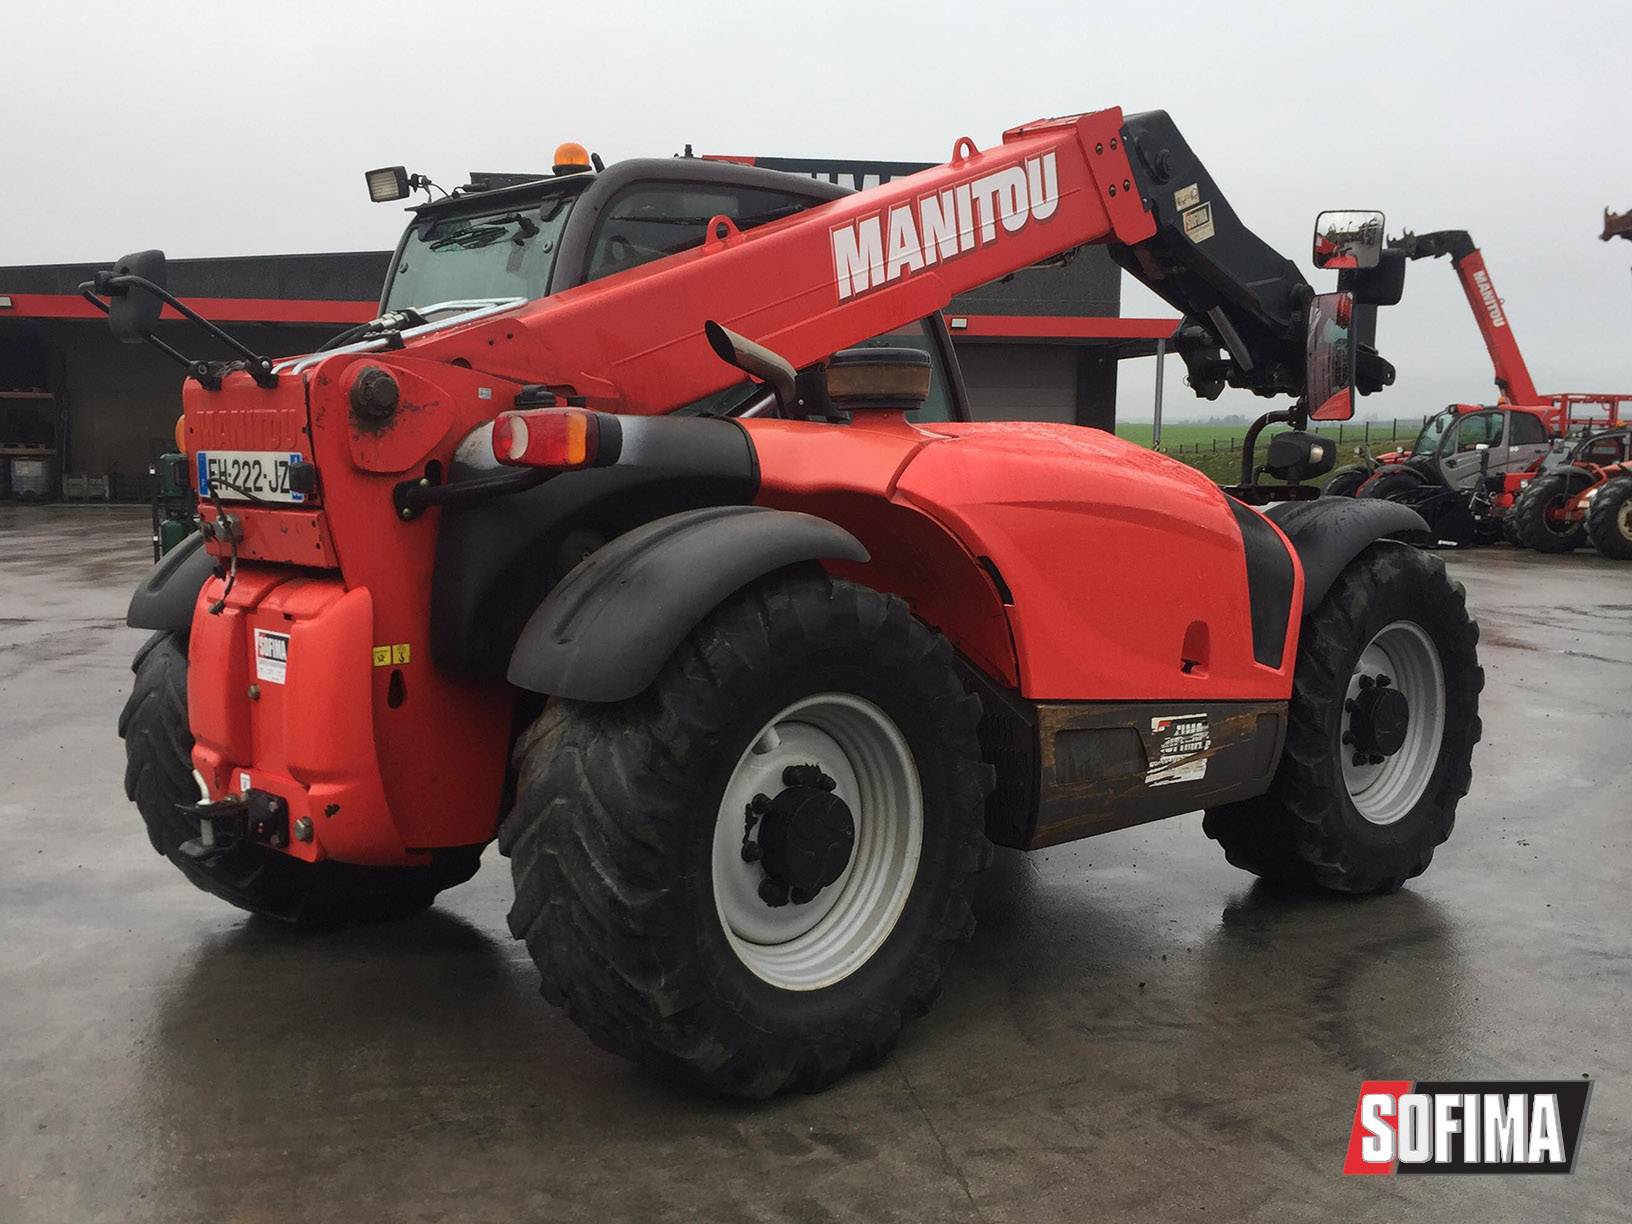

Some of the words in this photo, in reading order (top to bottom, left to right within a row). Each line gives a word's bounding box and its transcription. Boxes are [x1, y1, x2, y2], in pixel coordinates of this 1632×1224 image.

[831, 150, 1061, 301] MANITOU
[1473, 269, 1506, 328] MANITOU
[196, 408, 298, 450] MANITOU
